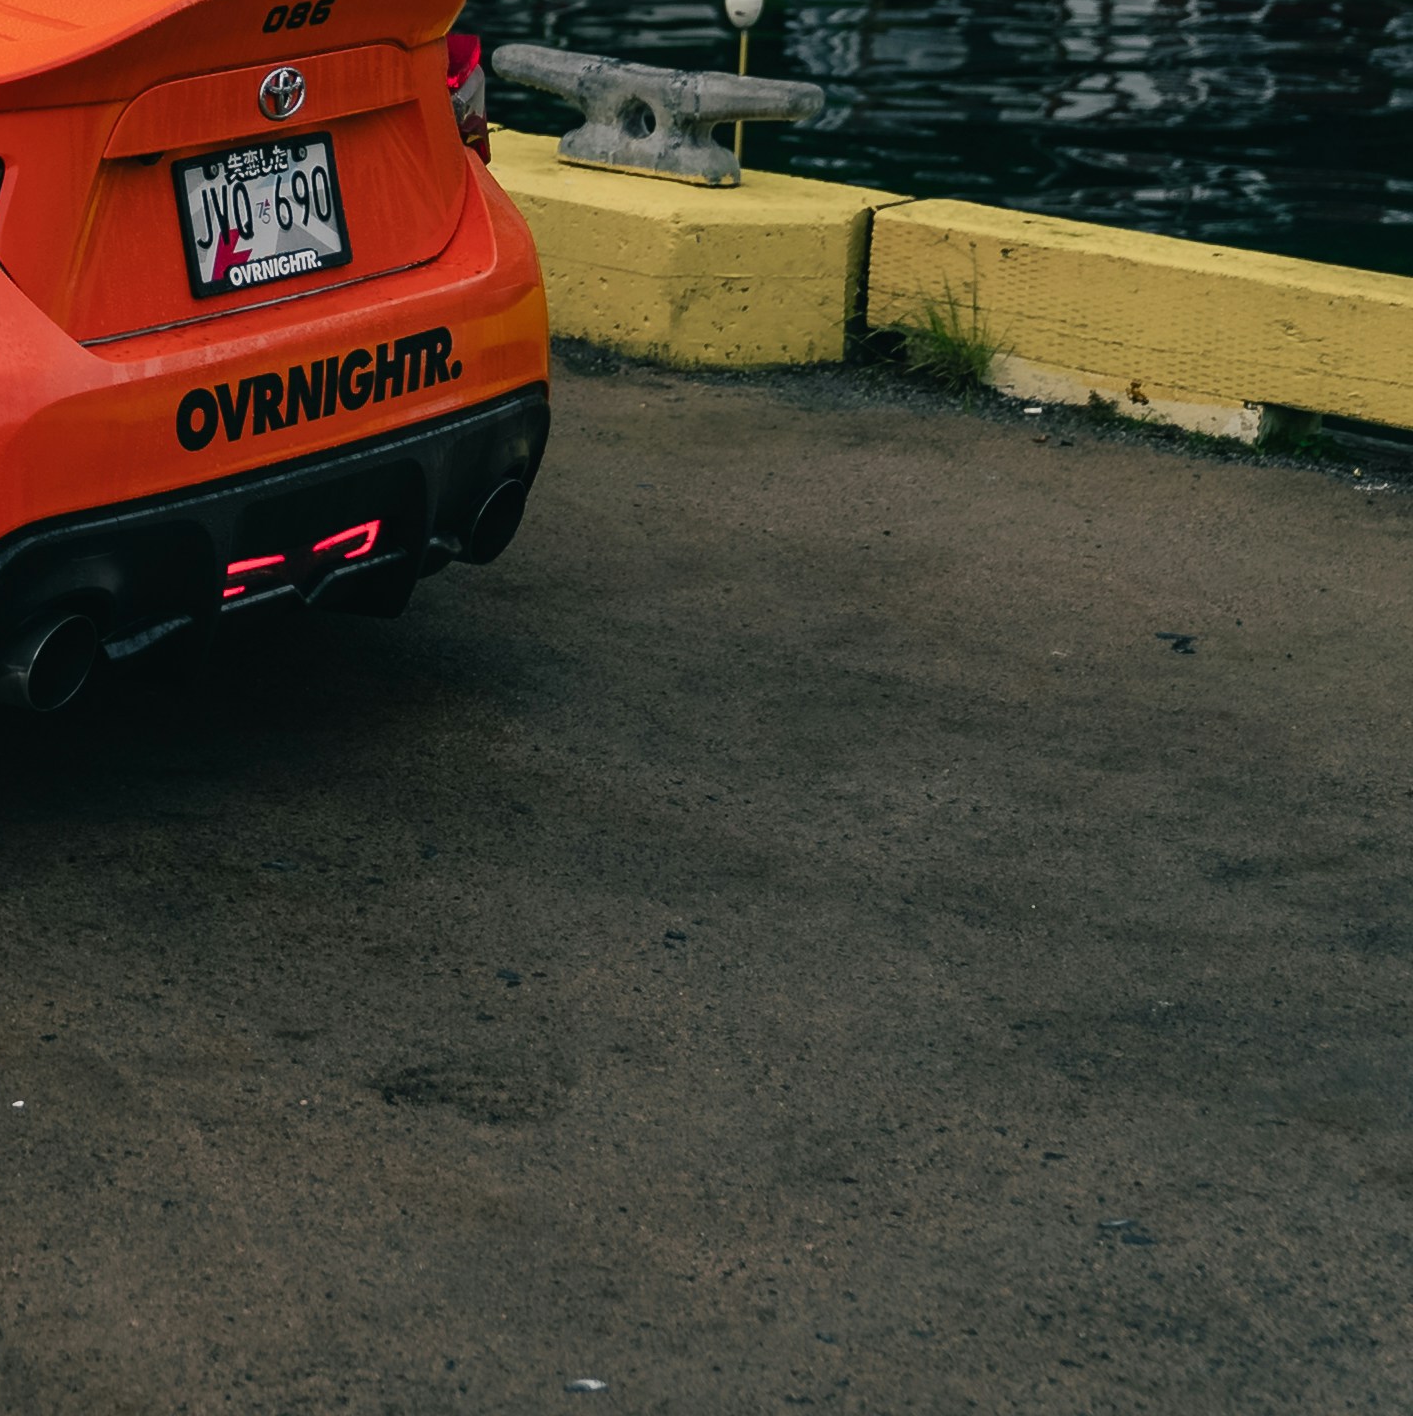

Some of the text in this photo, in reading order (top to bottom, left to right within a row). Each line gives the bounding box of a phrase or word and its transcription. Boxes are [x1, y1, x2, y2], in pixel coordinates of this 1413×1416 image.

[227, 144, 289, 183] 失恋した
[196, 165, 332, 250] JVQ 690
